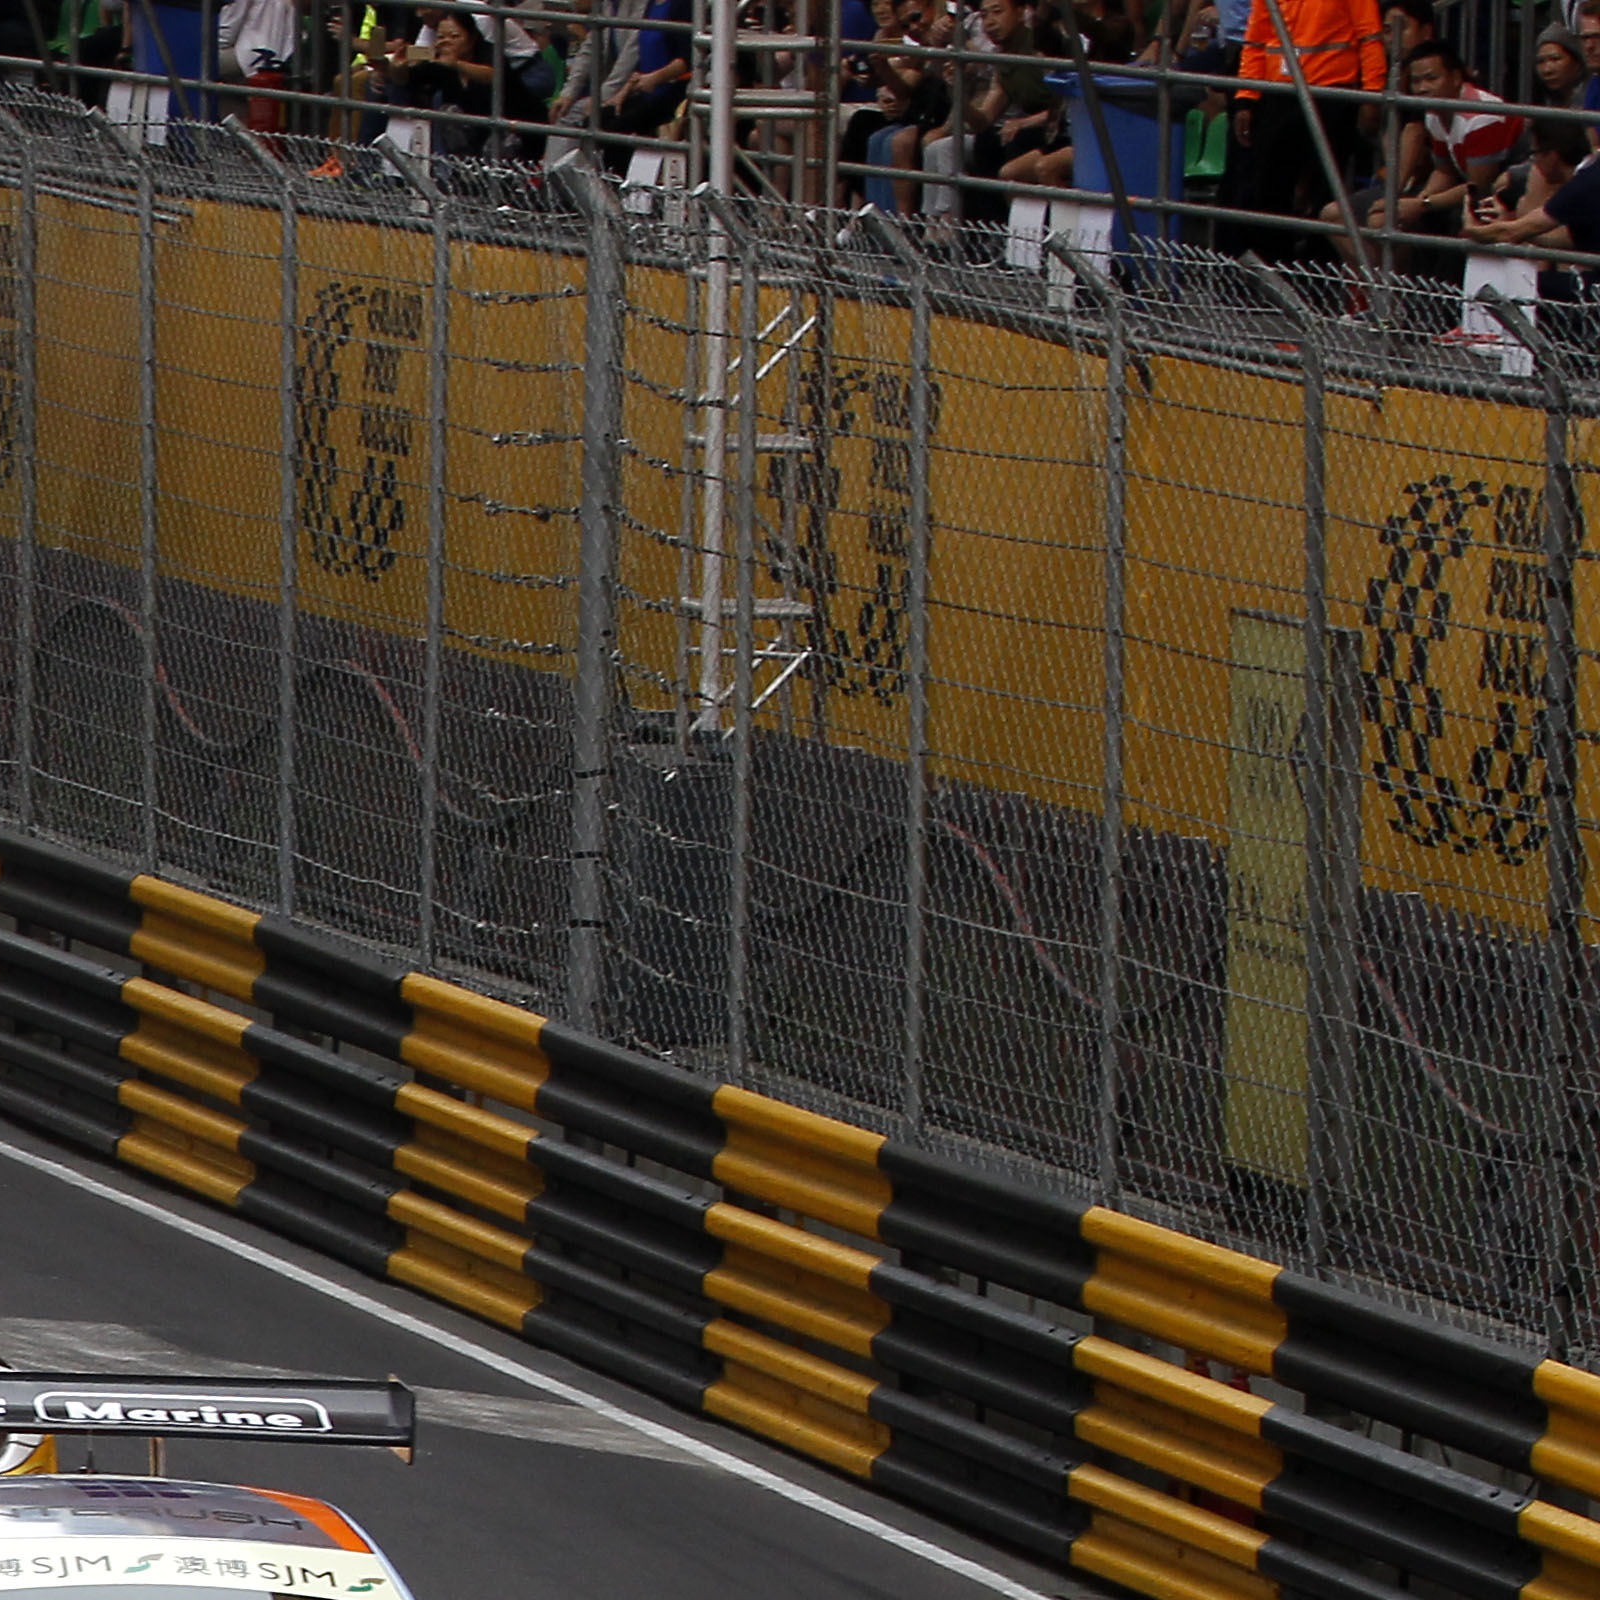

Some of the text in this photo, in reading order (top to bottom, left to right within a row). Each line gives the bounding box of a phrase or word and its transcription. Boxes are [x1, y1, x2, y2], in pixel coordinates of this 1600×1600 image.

[63, 1400, 306, 1430] Marine
[32, 1555, 113, 1577] SJM
[259, 1563, 339, 1588] SJM
